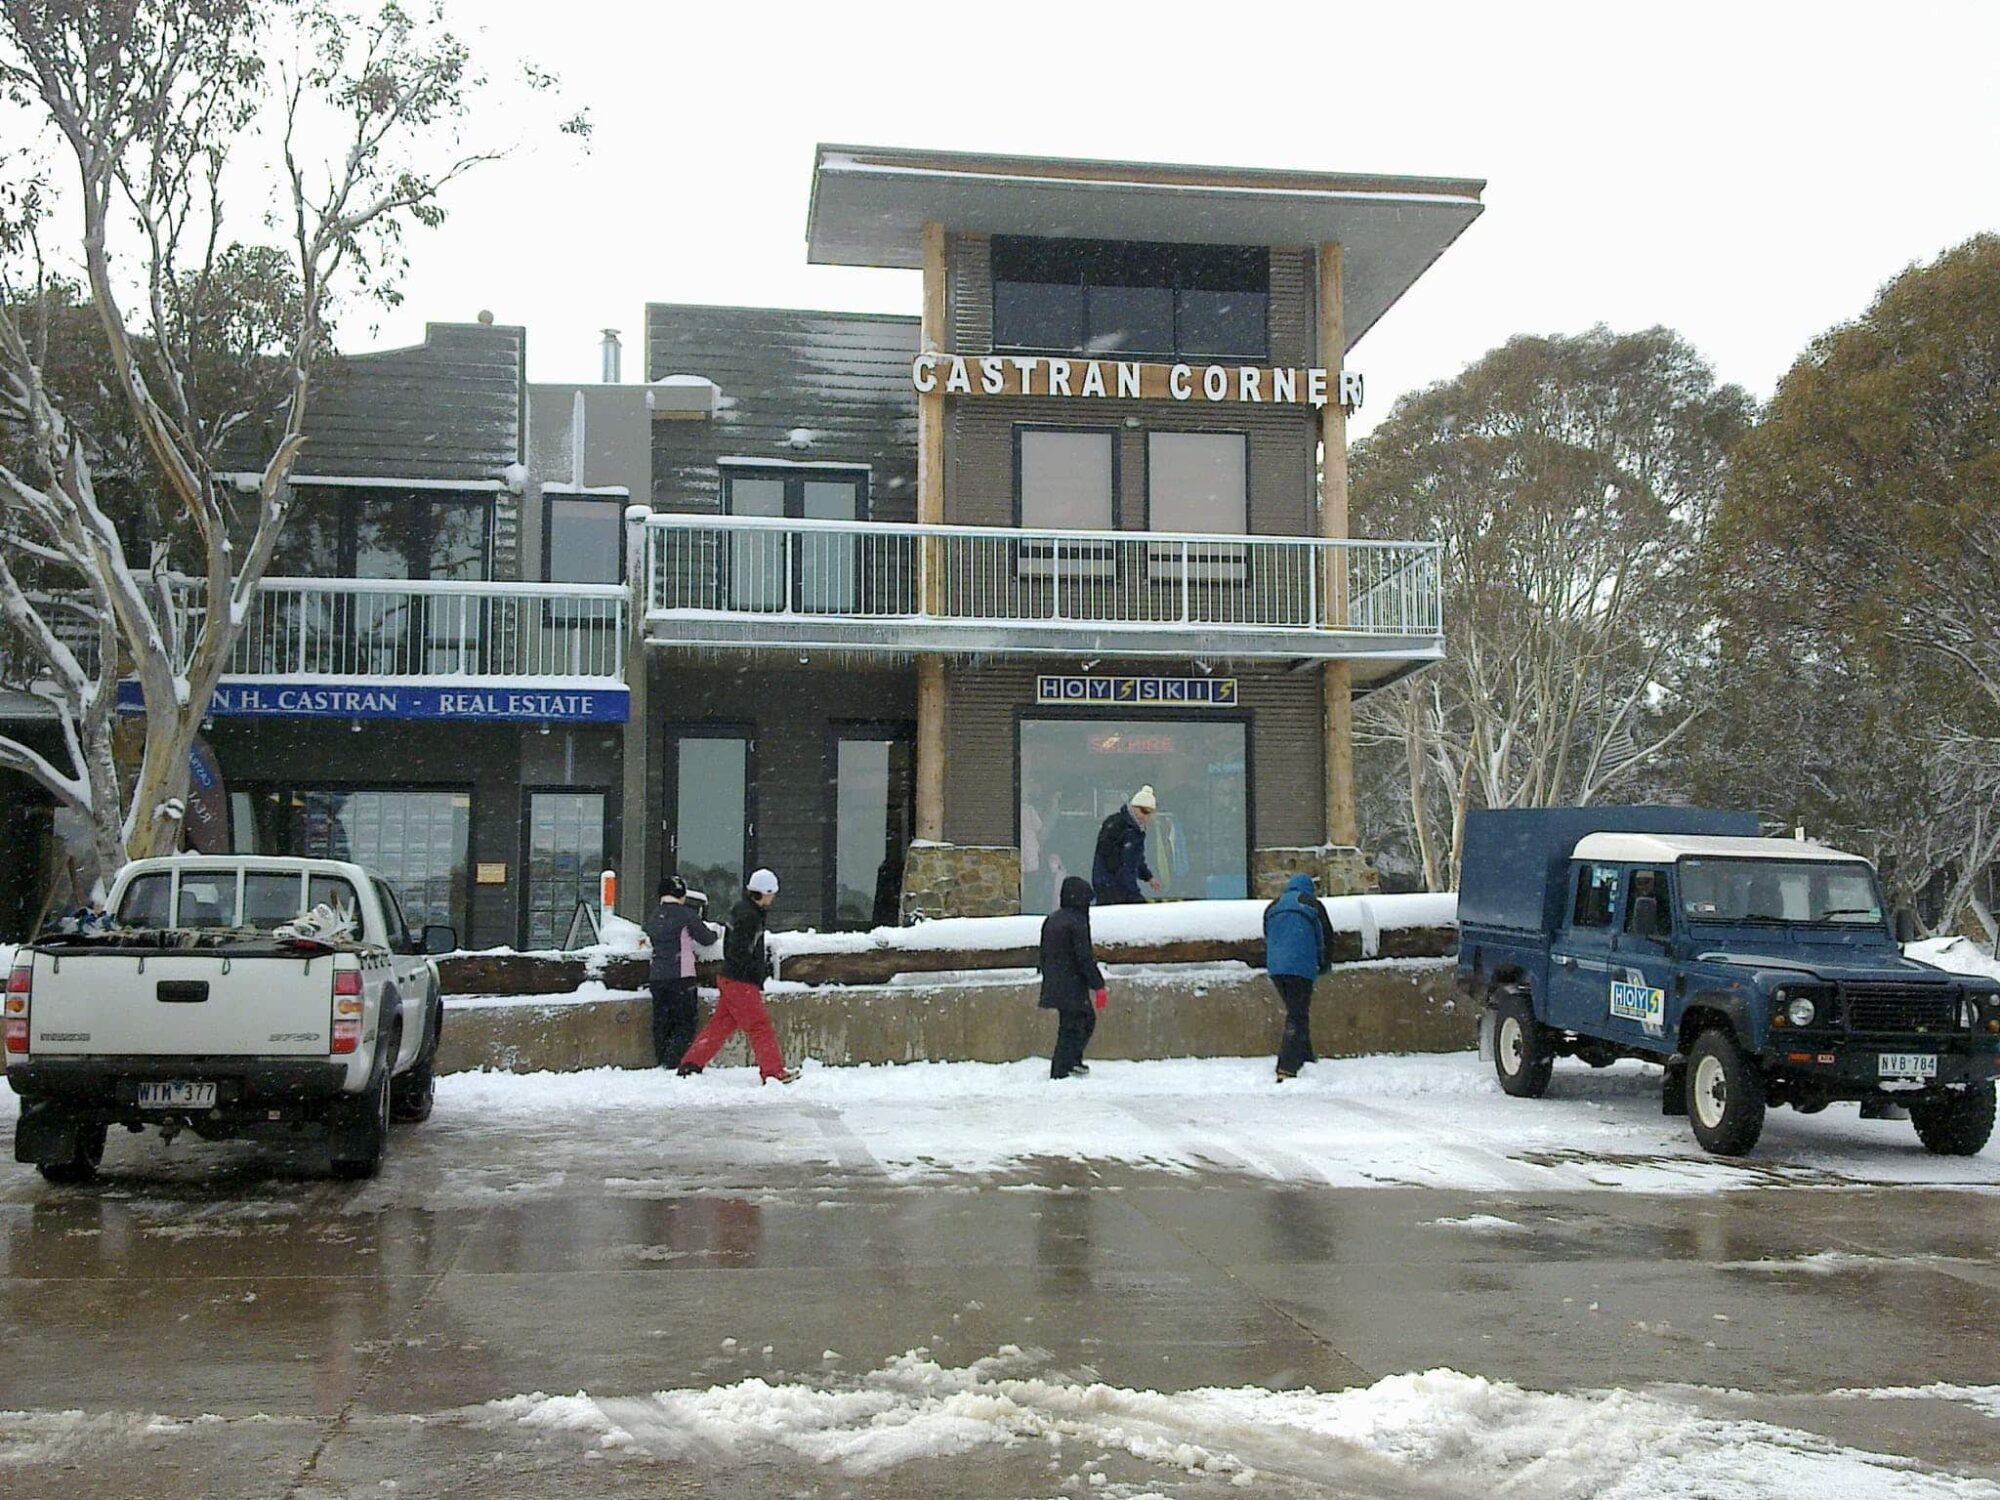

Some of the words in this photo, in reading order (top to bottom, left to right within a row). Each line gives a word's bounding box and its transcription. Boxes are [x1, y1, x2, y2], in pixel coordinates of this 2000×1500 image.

[912, 359, 1140, 399] CASTRAN
[1169, 363, 1363, 406] CORNER
[241, 691, 268, 709] H.
[278, 690, 397, 712] CASTRAN
[439, 694, 499, 714] REAL
[508, 695, 594, 715] ESTATE
[1913, 1056, 1935, 1072] 784
[184, 1084, 214, 1101] 377
